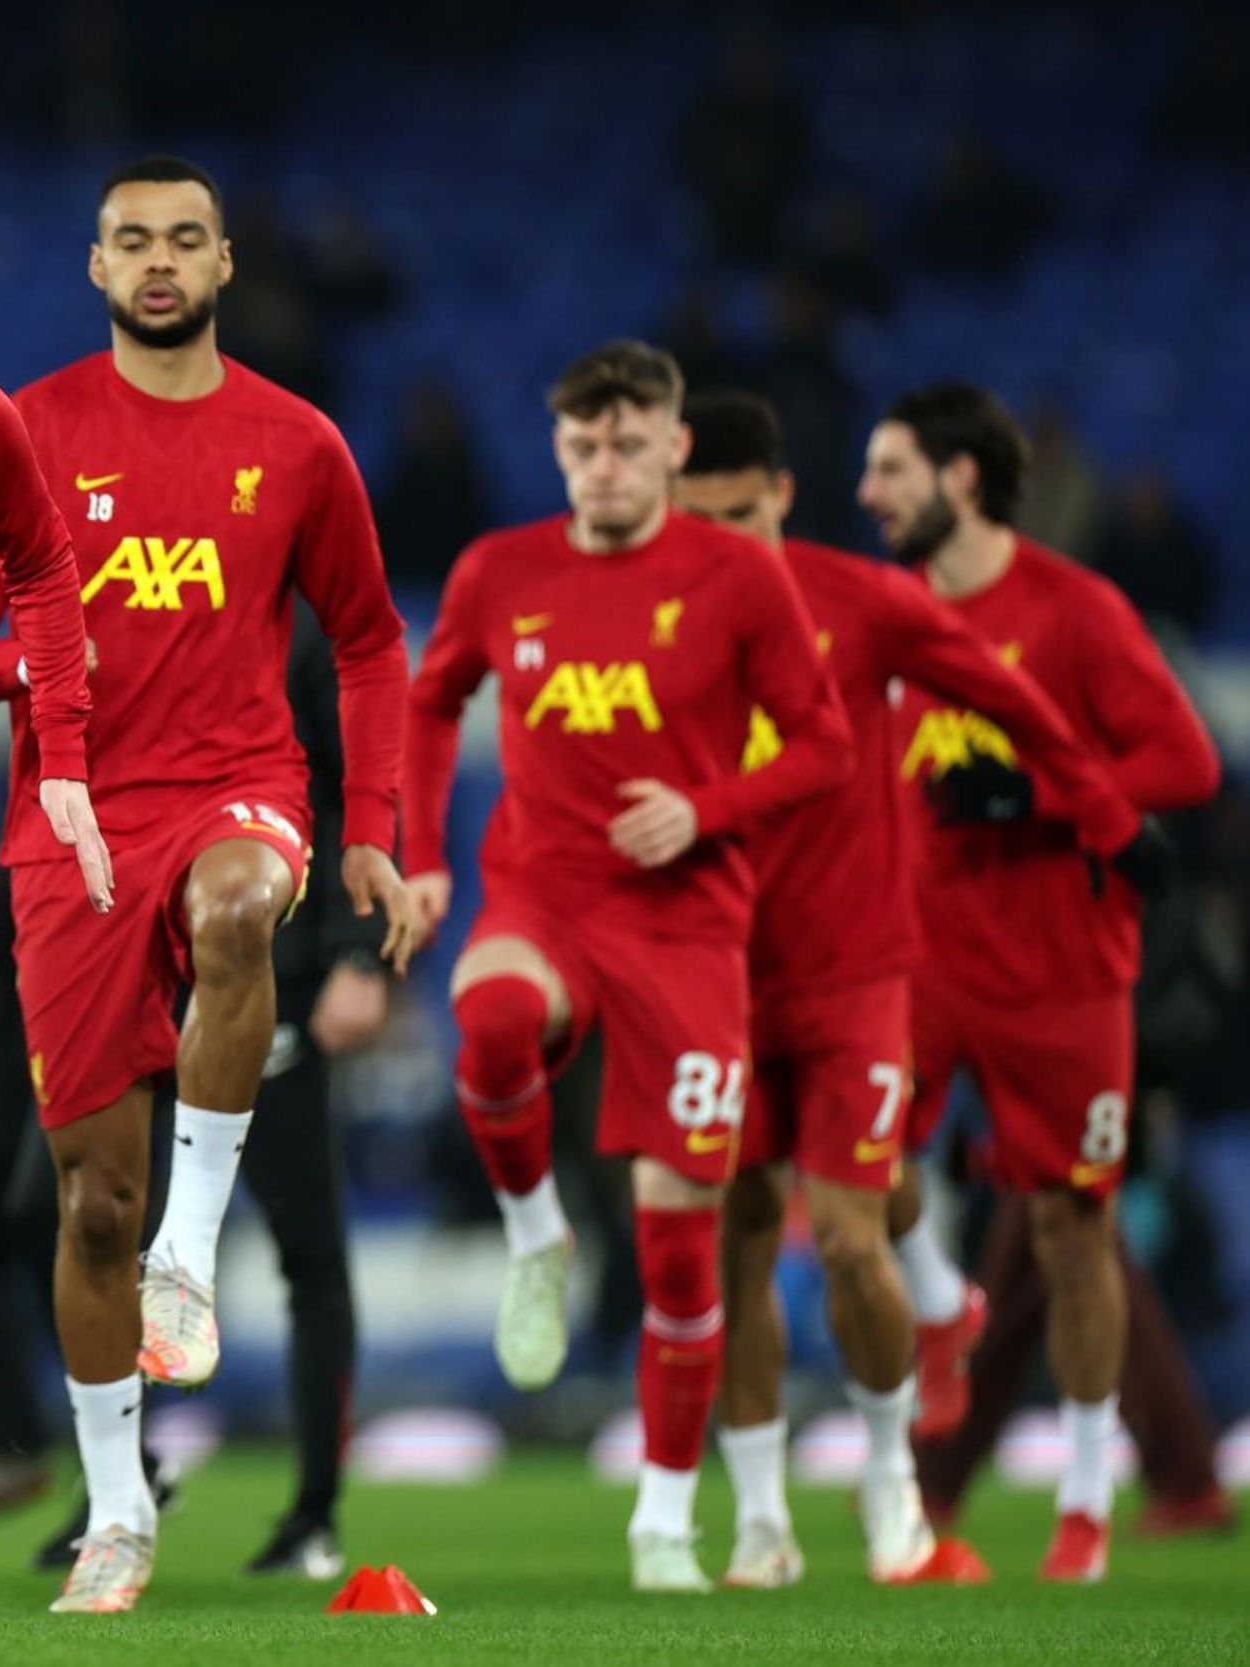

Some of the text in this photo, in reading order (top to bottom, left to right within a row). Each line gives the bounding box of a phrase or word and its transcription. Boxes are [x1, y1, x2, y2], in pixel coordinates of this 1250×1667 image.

[86, 492, 114, 522] 18
[80, 536, 225, 611] AXA
[524, 661, 663, 733] AXA
[668, 1051, 745, 1129] 84
[868, 1062, 901, 1140] 7
[1081, 1090, 1129, 1166] 8
